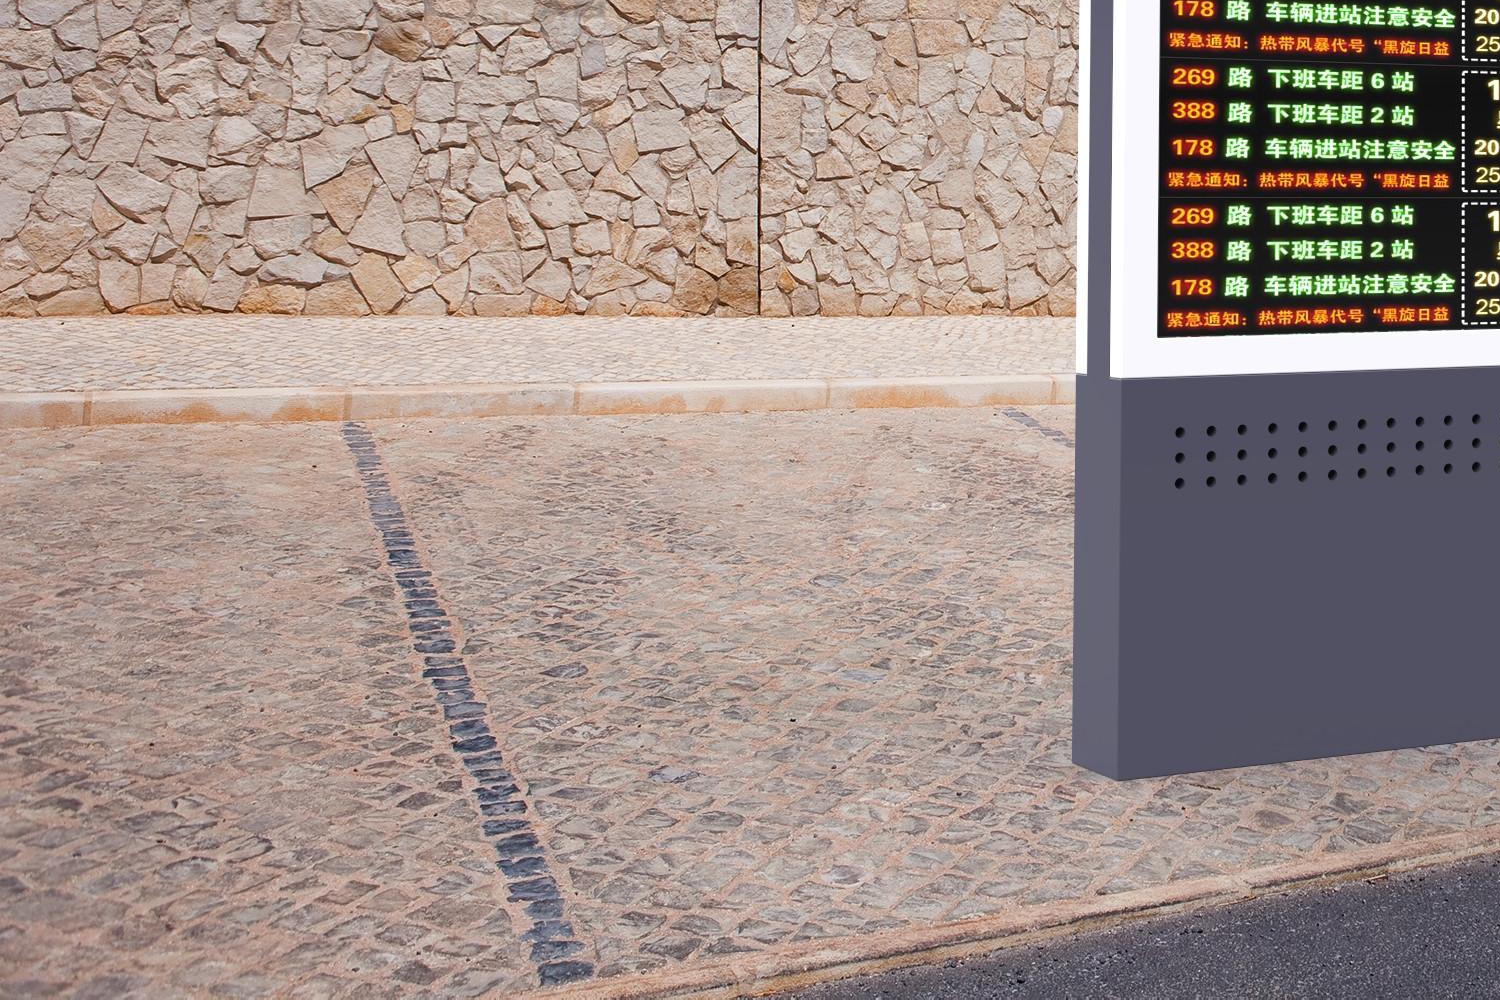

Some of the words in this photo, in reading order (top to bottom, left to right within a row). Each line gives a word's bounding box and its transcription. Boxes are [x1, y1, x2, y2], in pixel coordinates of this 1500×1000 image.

[1175, 1, 1213, 16] 178
[1227, 0, 1250, 20] 路
[1266, 2, 1455, 27] 车辆进站注意安全
[1174, 69, 1214, 84] 269
[1228, 67, 1252, 87] 路
[1268, 69, 1363, 89] 下班车距
[1371, 73, 1384, 88] 6
[1392, 72, 1414, 91] 站
[1174, 103, 1214, 118] 388
[1228, 103, 1252, 122] 路
[1268, 104, 1362, 124] 下班车距
[1371, 108, 1384, 122] 2
[1392, 106, 1414, 125] 站
[1174, 140, 1212, 155] 178
[1226, 138, 1249, 158] 路
[1265, 138, 1455, 159] 车辆进站注意安全
[1173, 209, 1213, 224] 269
[1227, 205, 1251, 225] 路
[1267, 205, 1362, 225] 下班车距
[1371, 207, 1384, 222] 6
[1392, 206, 1413, 225] 站
[1173, 242, 1213, 258] 388
[1227, 241, 1251, 261] 路
[1267, 240, 1362, 260] 下班车距
[1371, 242, 1383, 257] 2
[1392, 240, 1413, 259] 站
[1173, 280, 1211, 294] 178
[1225, 276, 1249, 296] 路
[1265, 274, 1455, 296] 车辆进站注意安全
